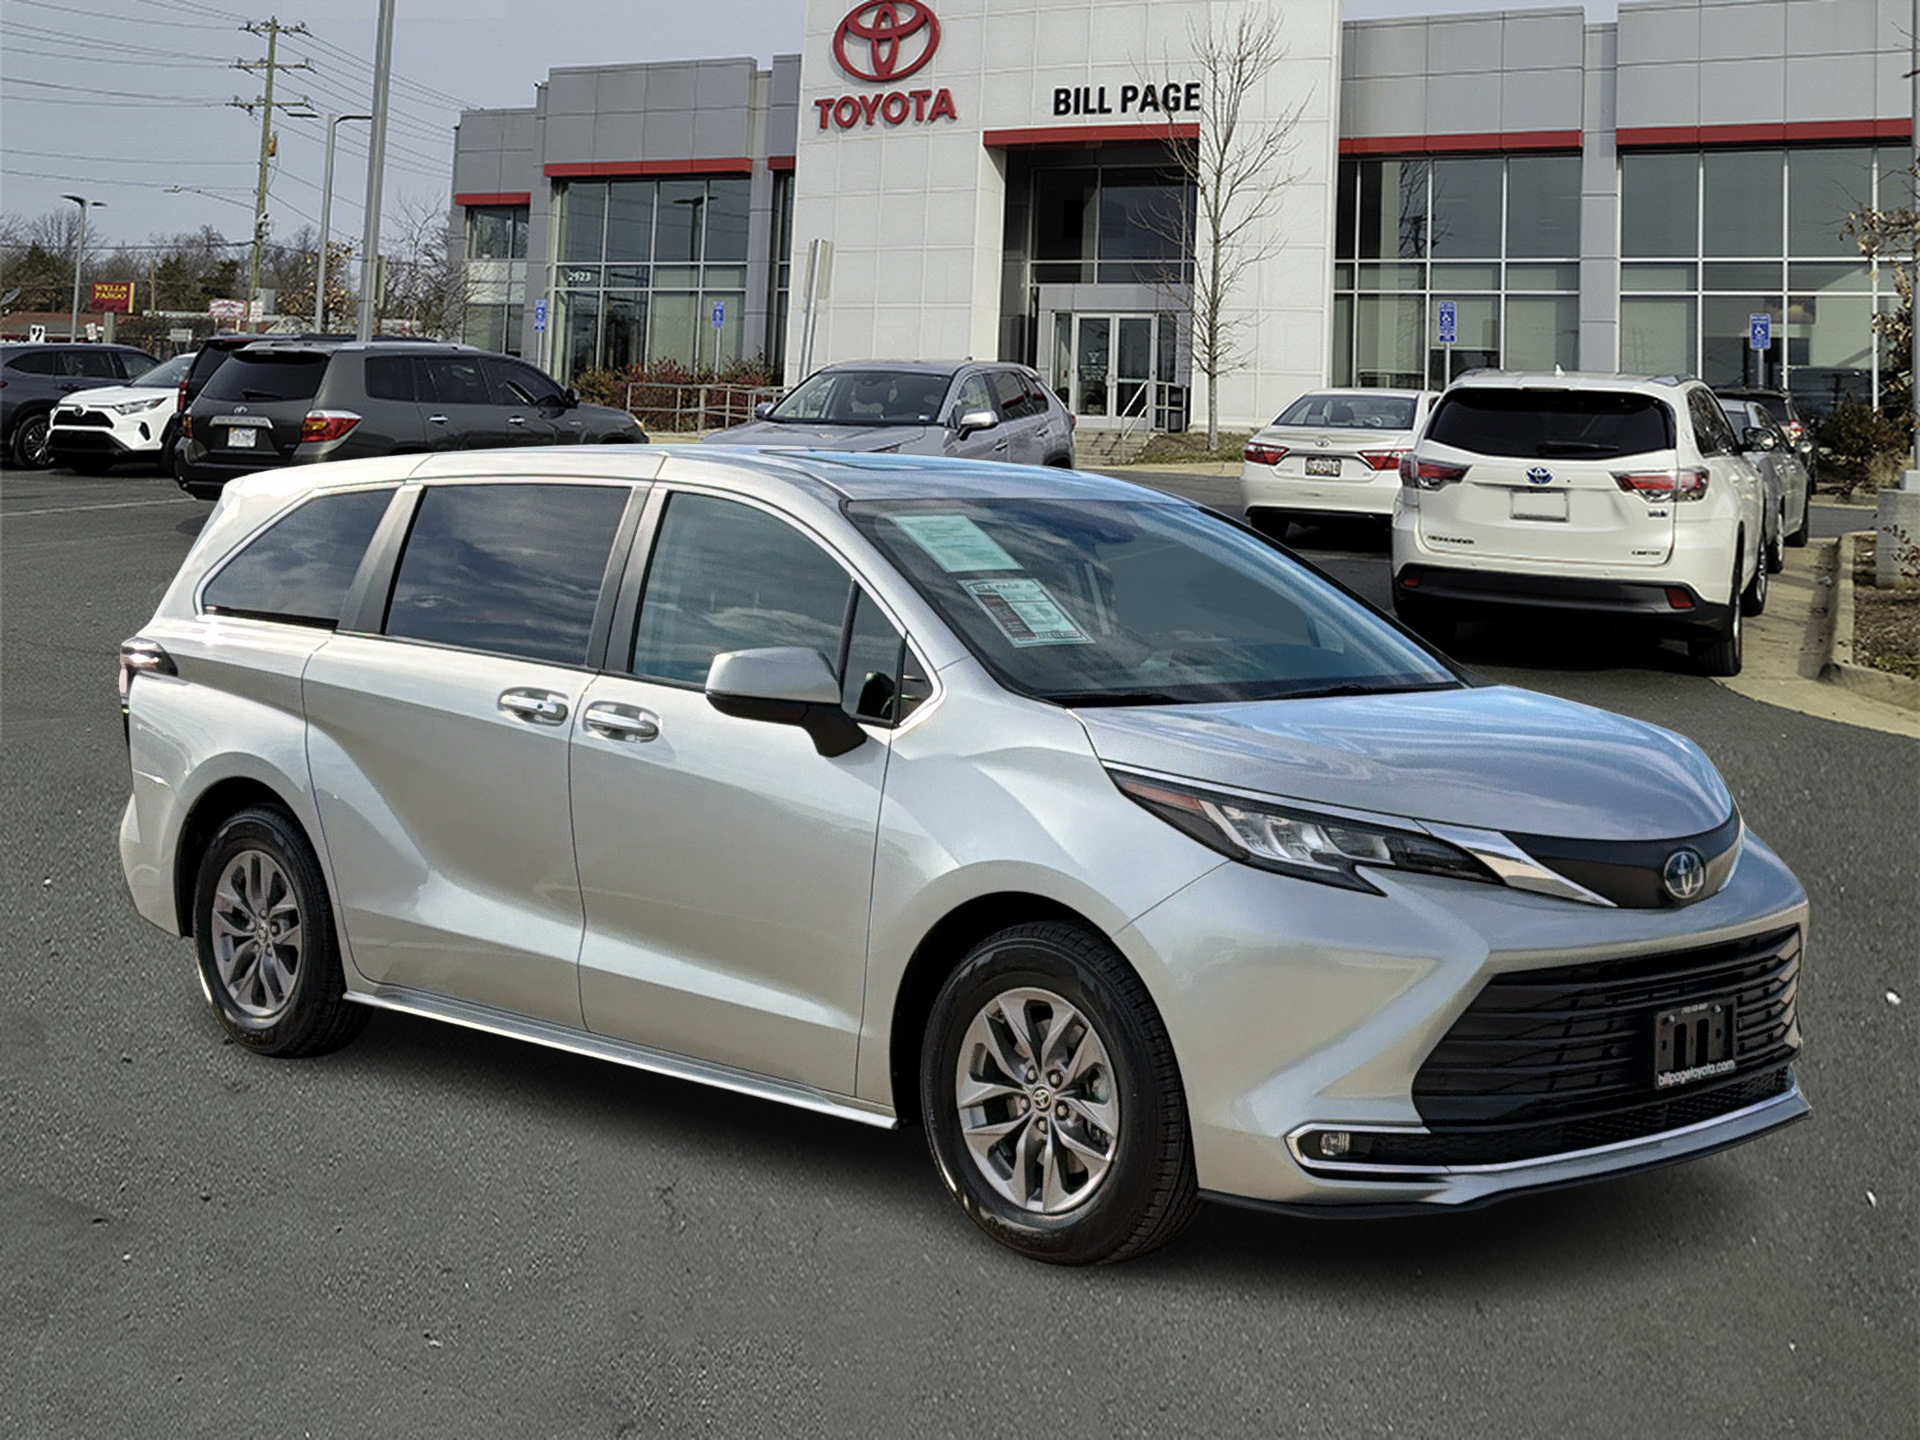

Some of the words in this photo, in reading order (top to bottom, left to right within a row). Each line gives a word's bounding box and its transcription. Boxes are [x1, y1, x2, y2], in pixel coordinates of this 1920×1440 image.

[814, 88, 957, 130] TOYOTA
[1053, 87, 1112, 116] BILL
[1119, 83, 1201, 113] PAGE
